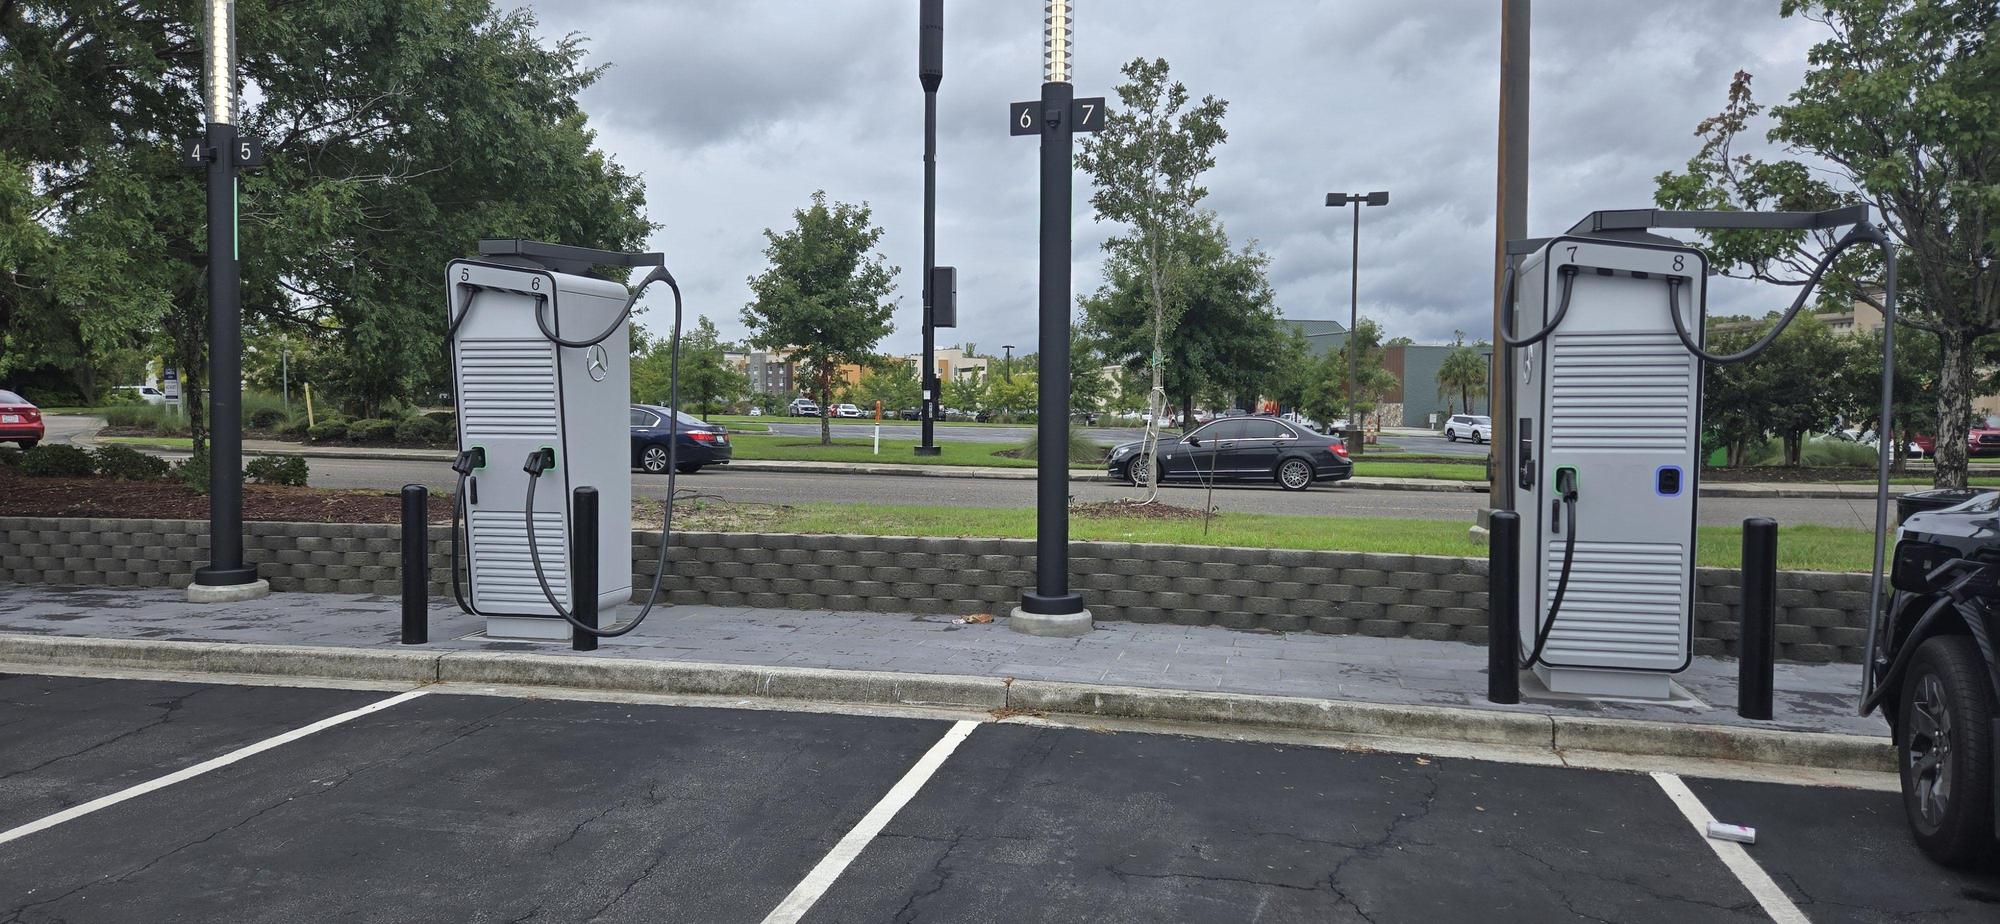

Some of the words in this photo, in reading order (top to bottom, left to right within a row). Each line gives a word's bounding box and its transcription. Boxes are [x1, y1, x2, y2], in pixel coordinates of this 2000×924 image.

[1020, 108, 1032, 129] 6
[1082, 104, 1094, 125] 7
[191, 143, 200, 162] 4
[241, 142, 251, 160] 5
[1566, 246, 1578, 263] 7
[1672, 254, 1684, 272] 8
[461, 267, 470, 282] 5
[531, 276, 541, 291] 6
